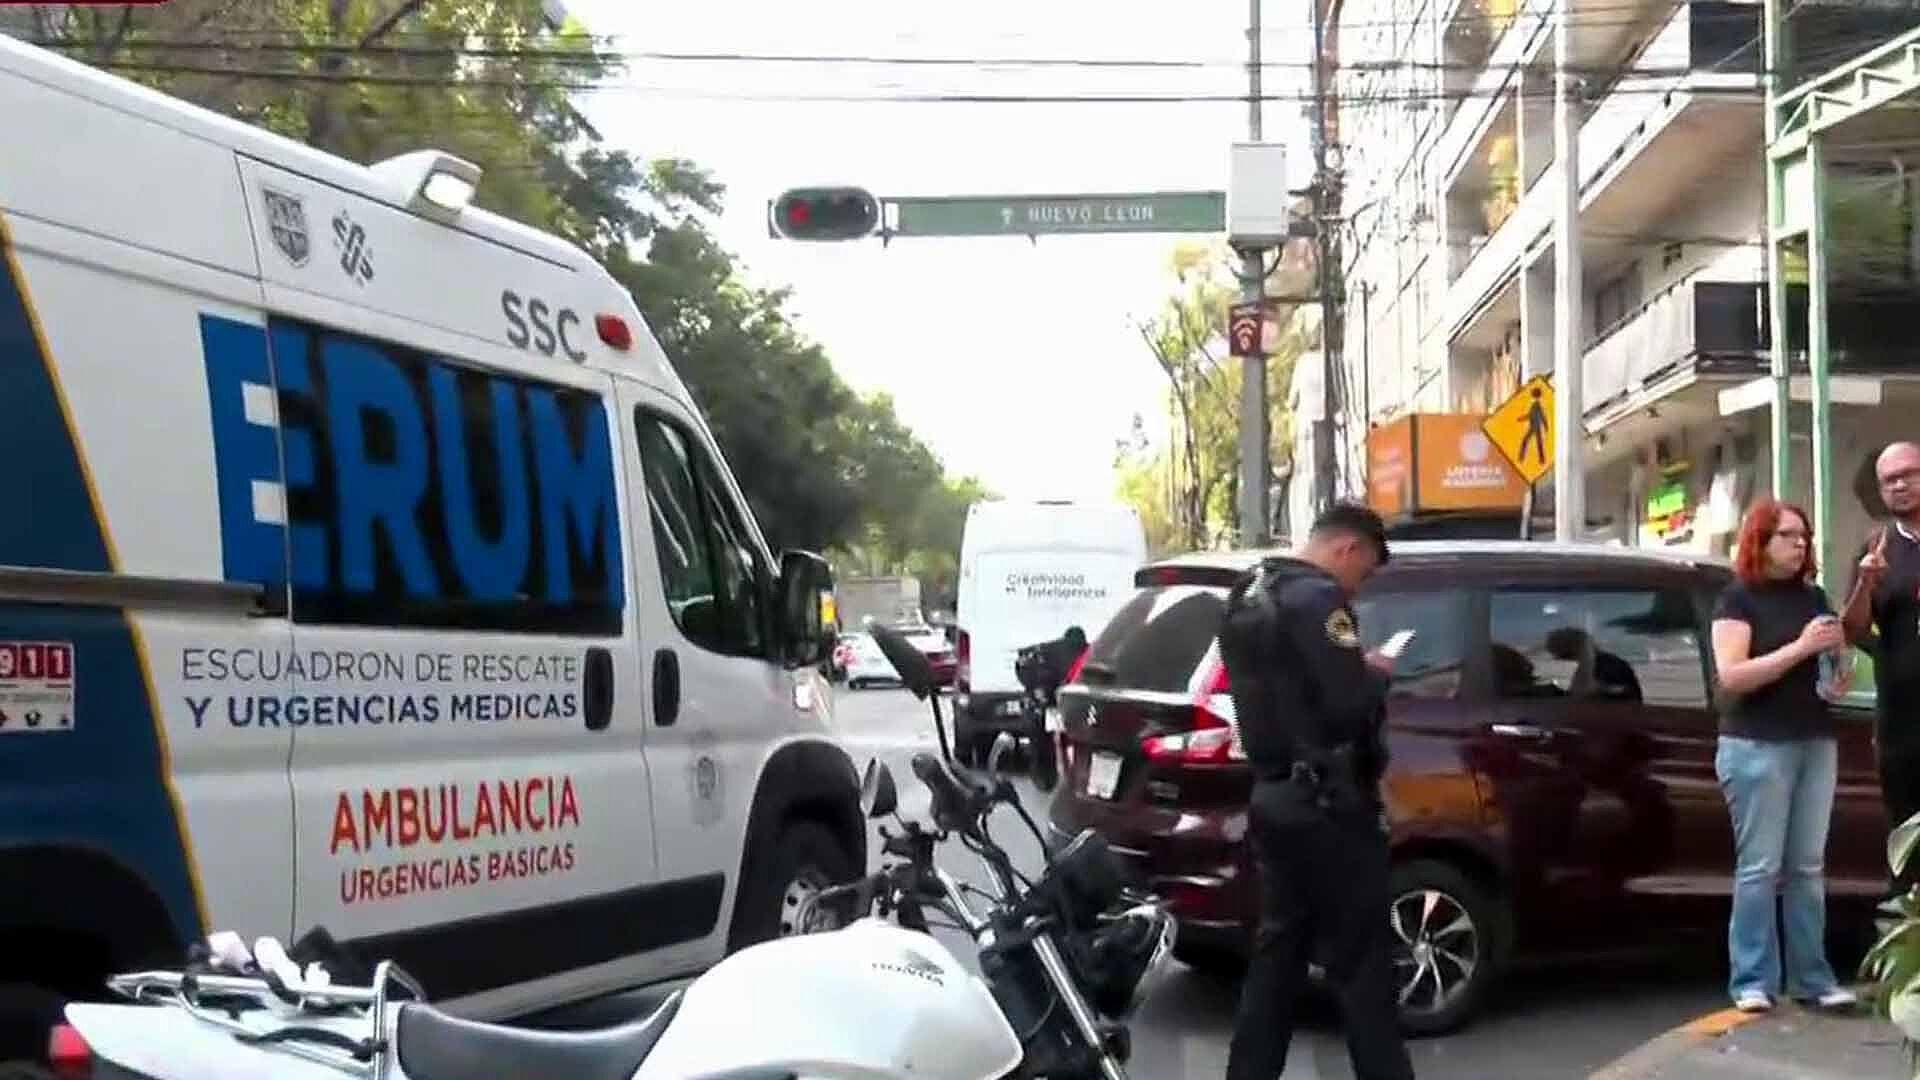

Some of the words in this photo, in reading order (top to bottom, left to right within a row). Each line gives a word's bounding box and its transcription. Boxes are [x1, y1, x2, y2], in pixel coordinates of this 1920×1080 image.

[1028, 204, 1092, 223] NUEVO
[501, 289, 587, 364] SSC
[199, 313, 626, 609] ERUM
[0, 647, 64, 675] 911
[182, 647, 405, 682] ESCUADRON
[415, 653, 453, 682] DE
[463, 654, 577, 682] RESCATE
[184, 696, 212, 728] Y
[227, 695, 440, 727] URGENCIAS
[451, 693, 577, 721] MEDICAS
[330, 775, 579, 856] AMBULANCIA
[340, 855, 480, 904] URGENCIAS
[487, 843, 575, 881] BASICAS
